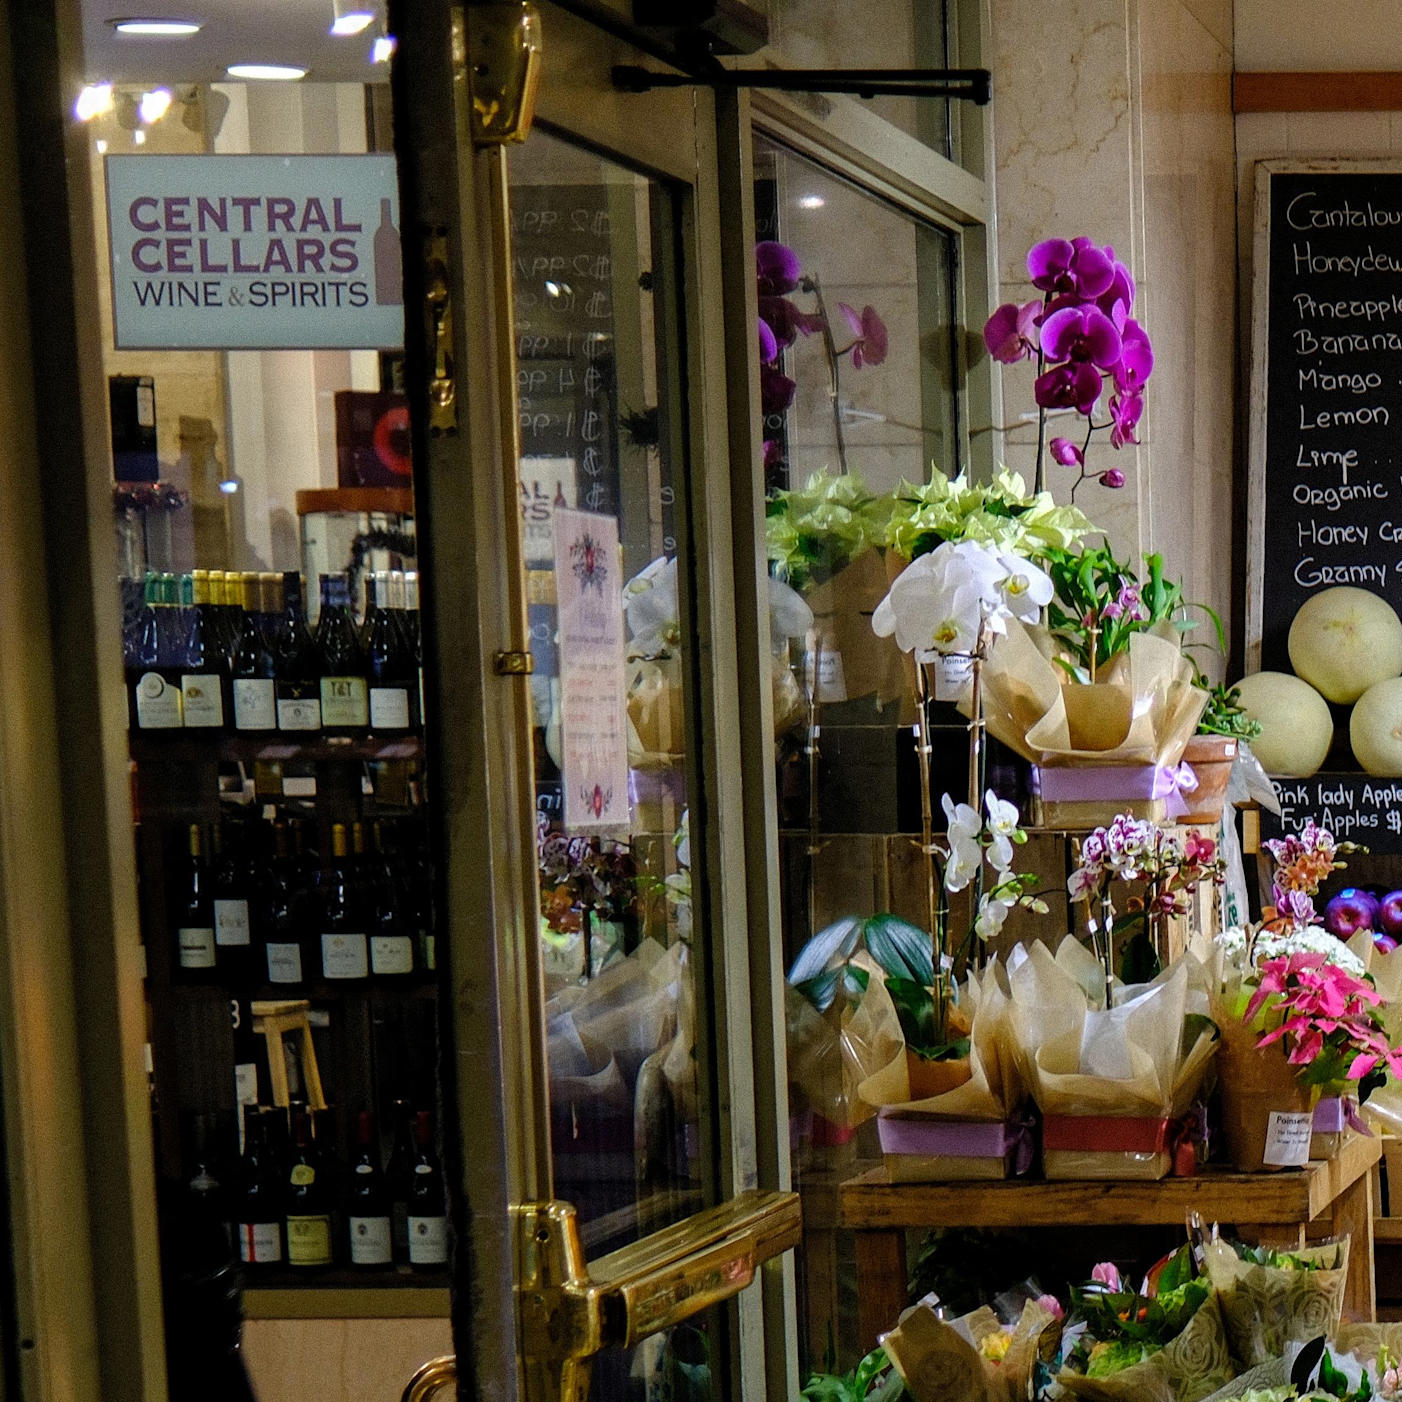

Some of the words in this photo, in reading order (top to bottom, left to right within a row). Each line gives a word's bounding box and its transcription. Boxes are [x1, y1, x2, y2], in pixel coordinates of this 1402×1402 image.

[129, 196, 362, 232] CENTRAL
[131, 238, 359, 273] CELLARS
[133, 281, 222, 306] WINE
[228, 287, 244, 306] &
[249, 281, 368, 307] SPIRITS
[1299, 369, 1382, 393] Mango
[1300, 405, 1389, 429] Lemon
[1297, 444, 1358, 475] Lime
[1293, 481, 1388, 510] Organic
[1298, 519, 1368, 547] Honey
[1294, 557, 1386, 587] Granny
[1318, 783, 1354, 809] lady
[1322, 807, 1379, 836] Apples
